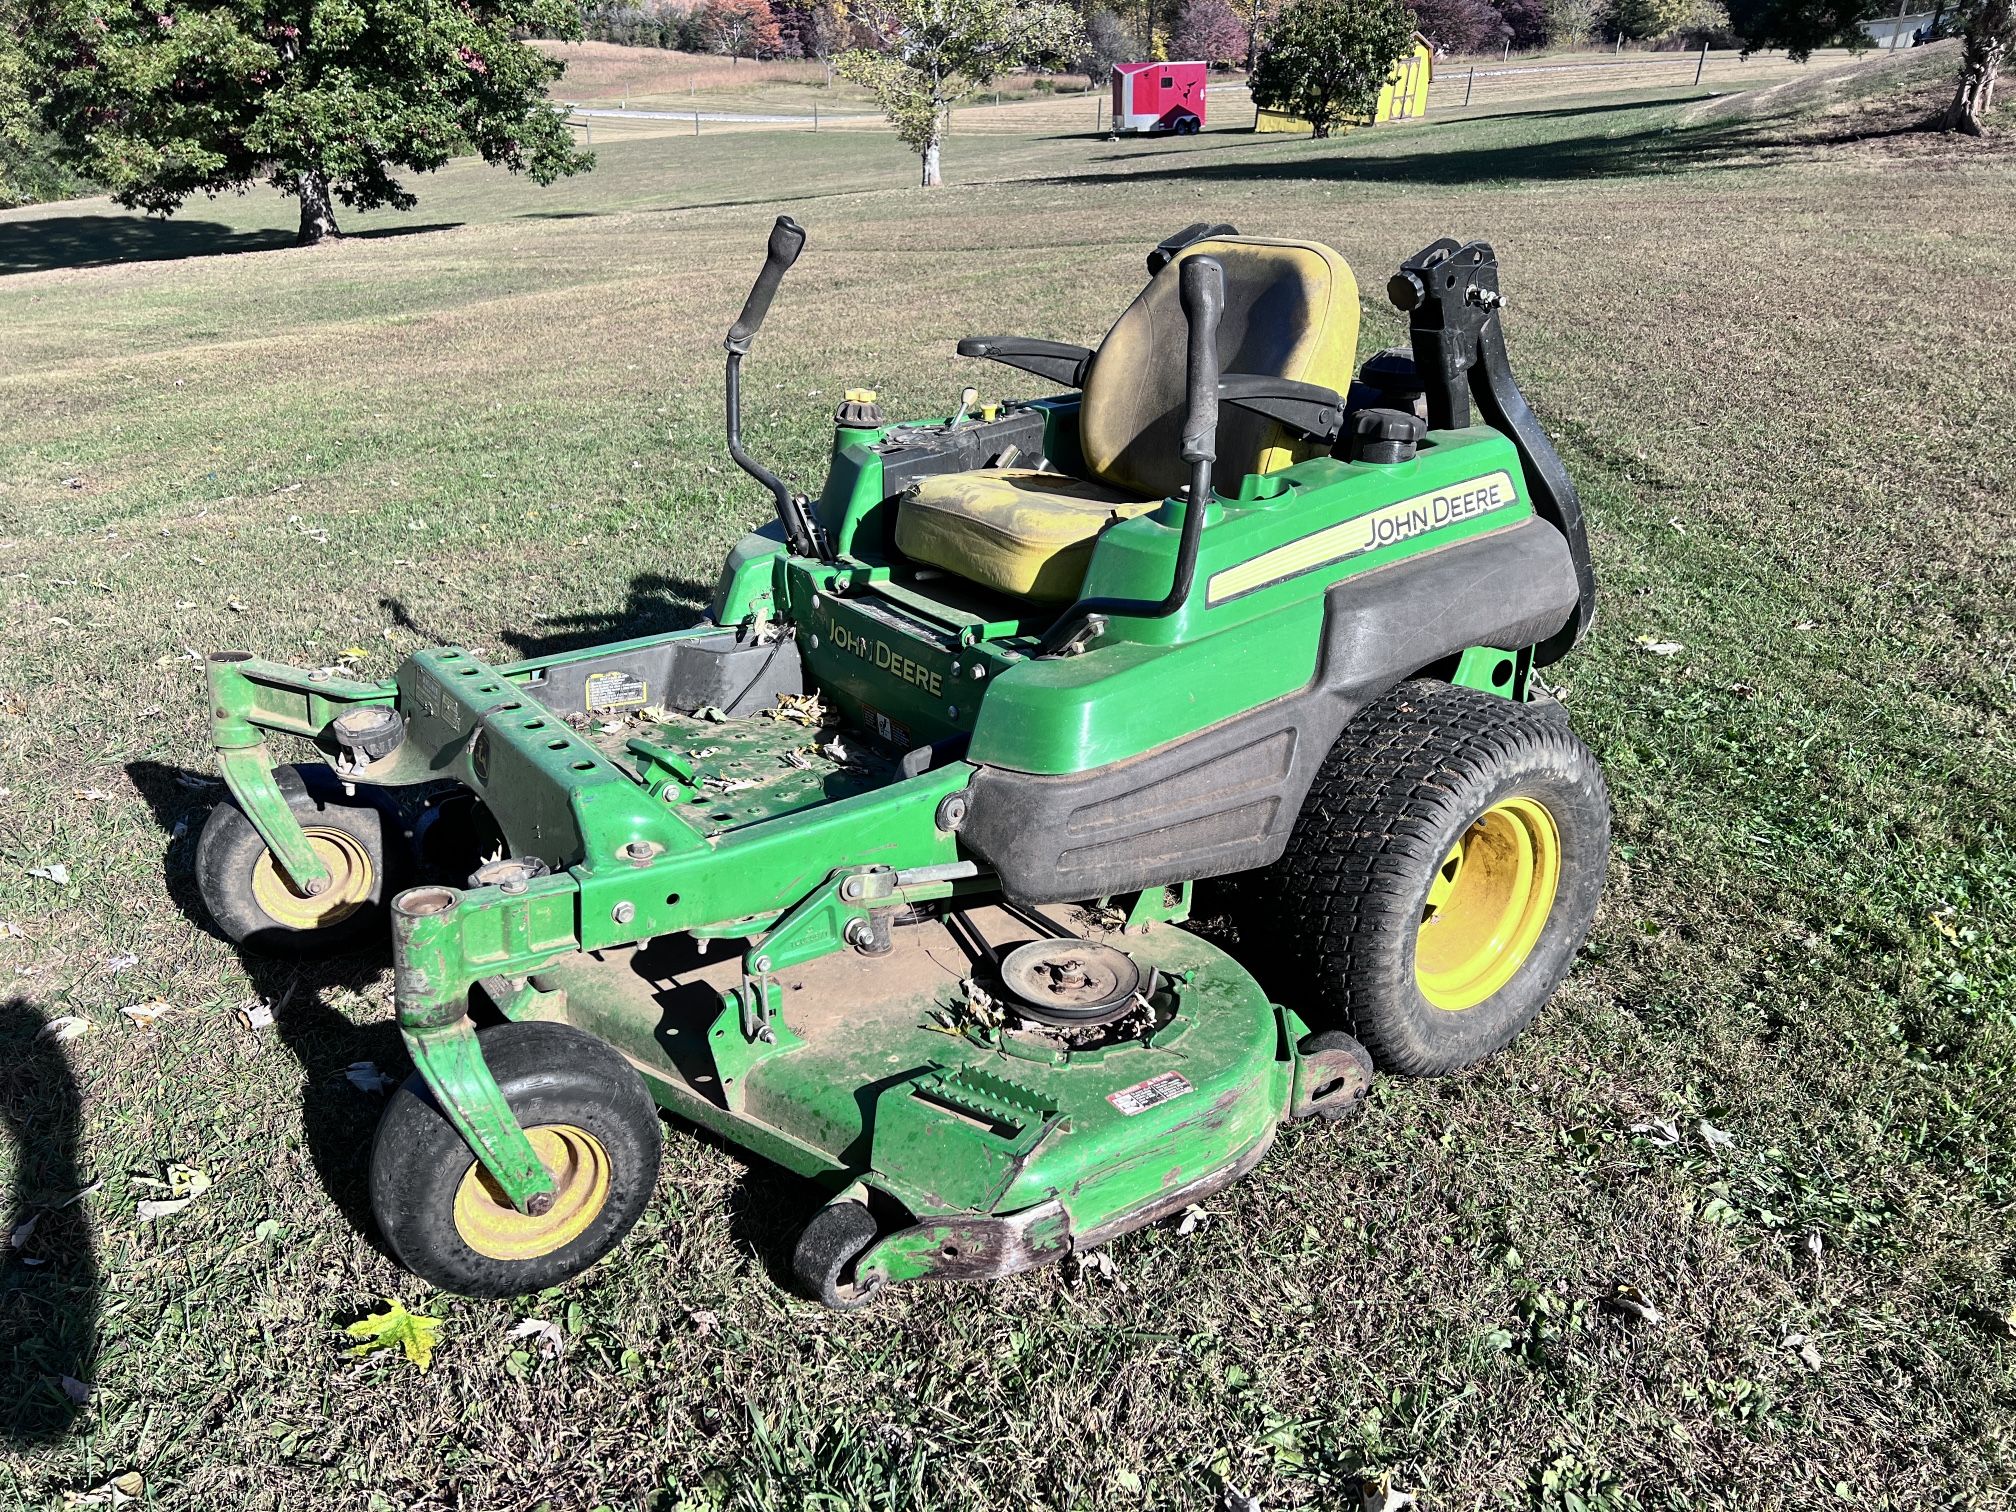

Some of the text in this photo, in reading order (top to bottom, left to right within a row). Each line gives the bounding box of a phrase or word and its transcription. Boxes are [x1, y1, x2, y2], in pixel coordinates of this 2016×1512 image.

[1364, 485, 1501, 548] JOHN DEERE
[875, 640, 943, 697] DEERE
